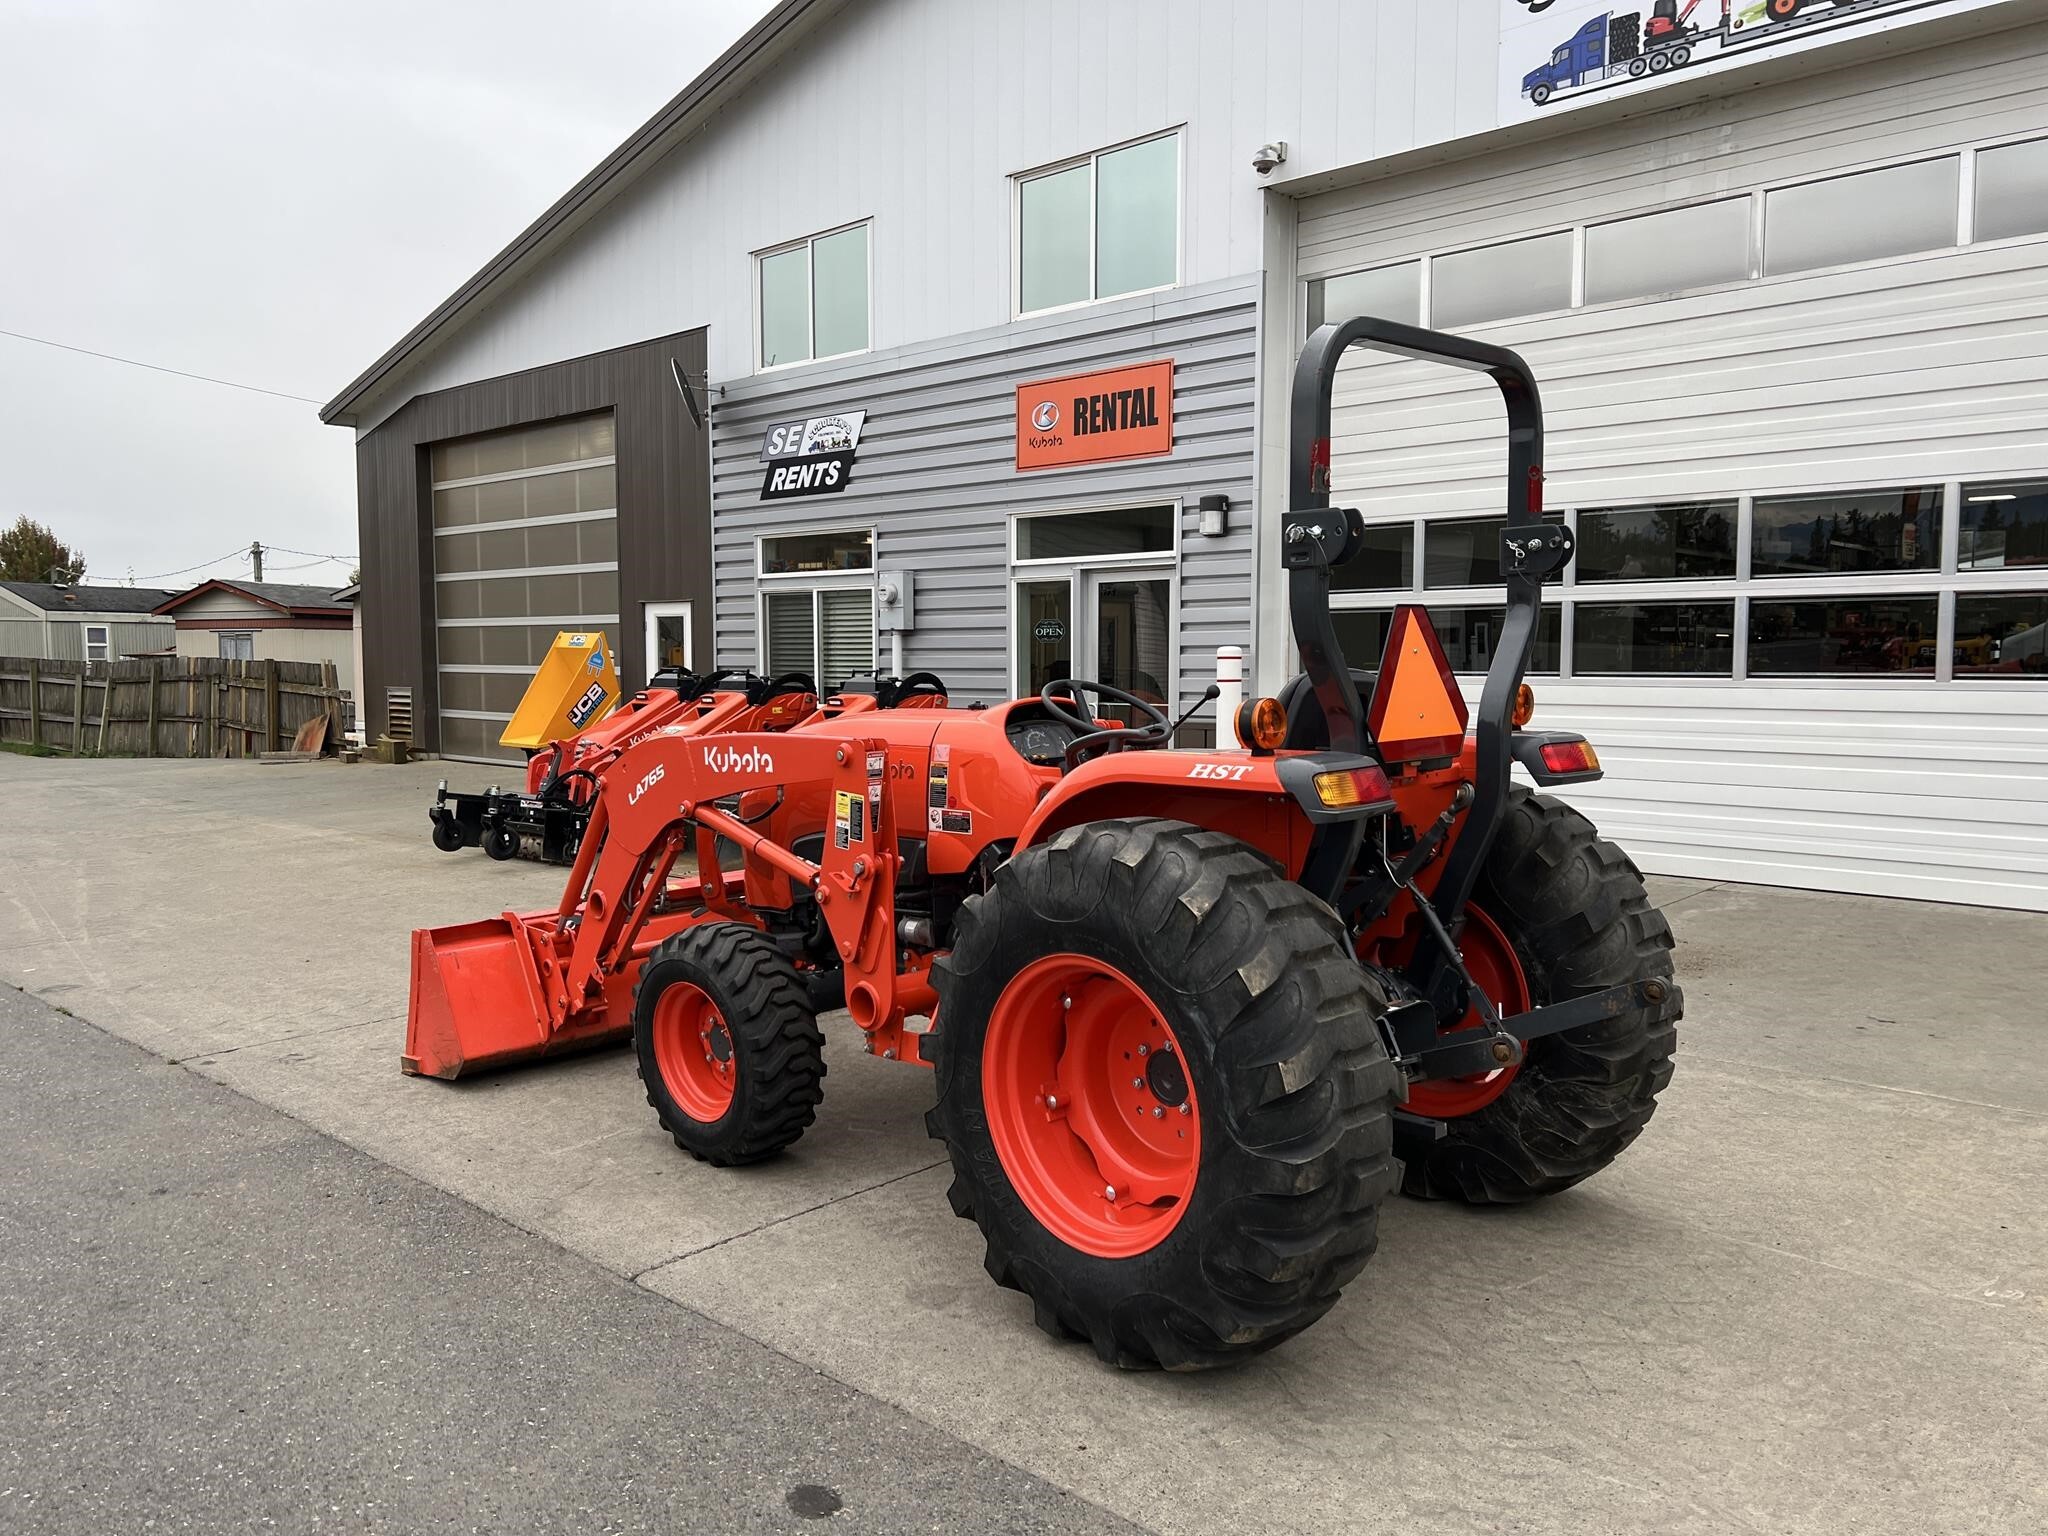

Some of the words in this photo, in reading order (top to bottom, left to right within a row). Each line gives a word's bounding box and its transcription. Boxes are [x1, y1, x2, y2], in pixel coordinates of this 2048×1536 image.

[1073, 387, 1159, 436] RENTAL
[768, 425, 803, 455] SE
[1029, 435, 1063, 448] Kubota
[770, 461, 841, 491] RENTS
[571, 683, 603, 724] JCB
[704, 746, 773, 773] Kubota
[1186, 763, 1254, 781] HST
[628, 763, 665, 805] LA765
